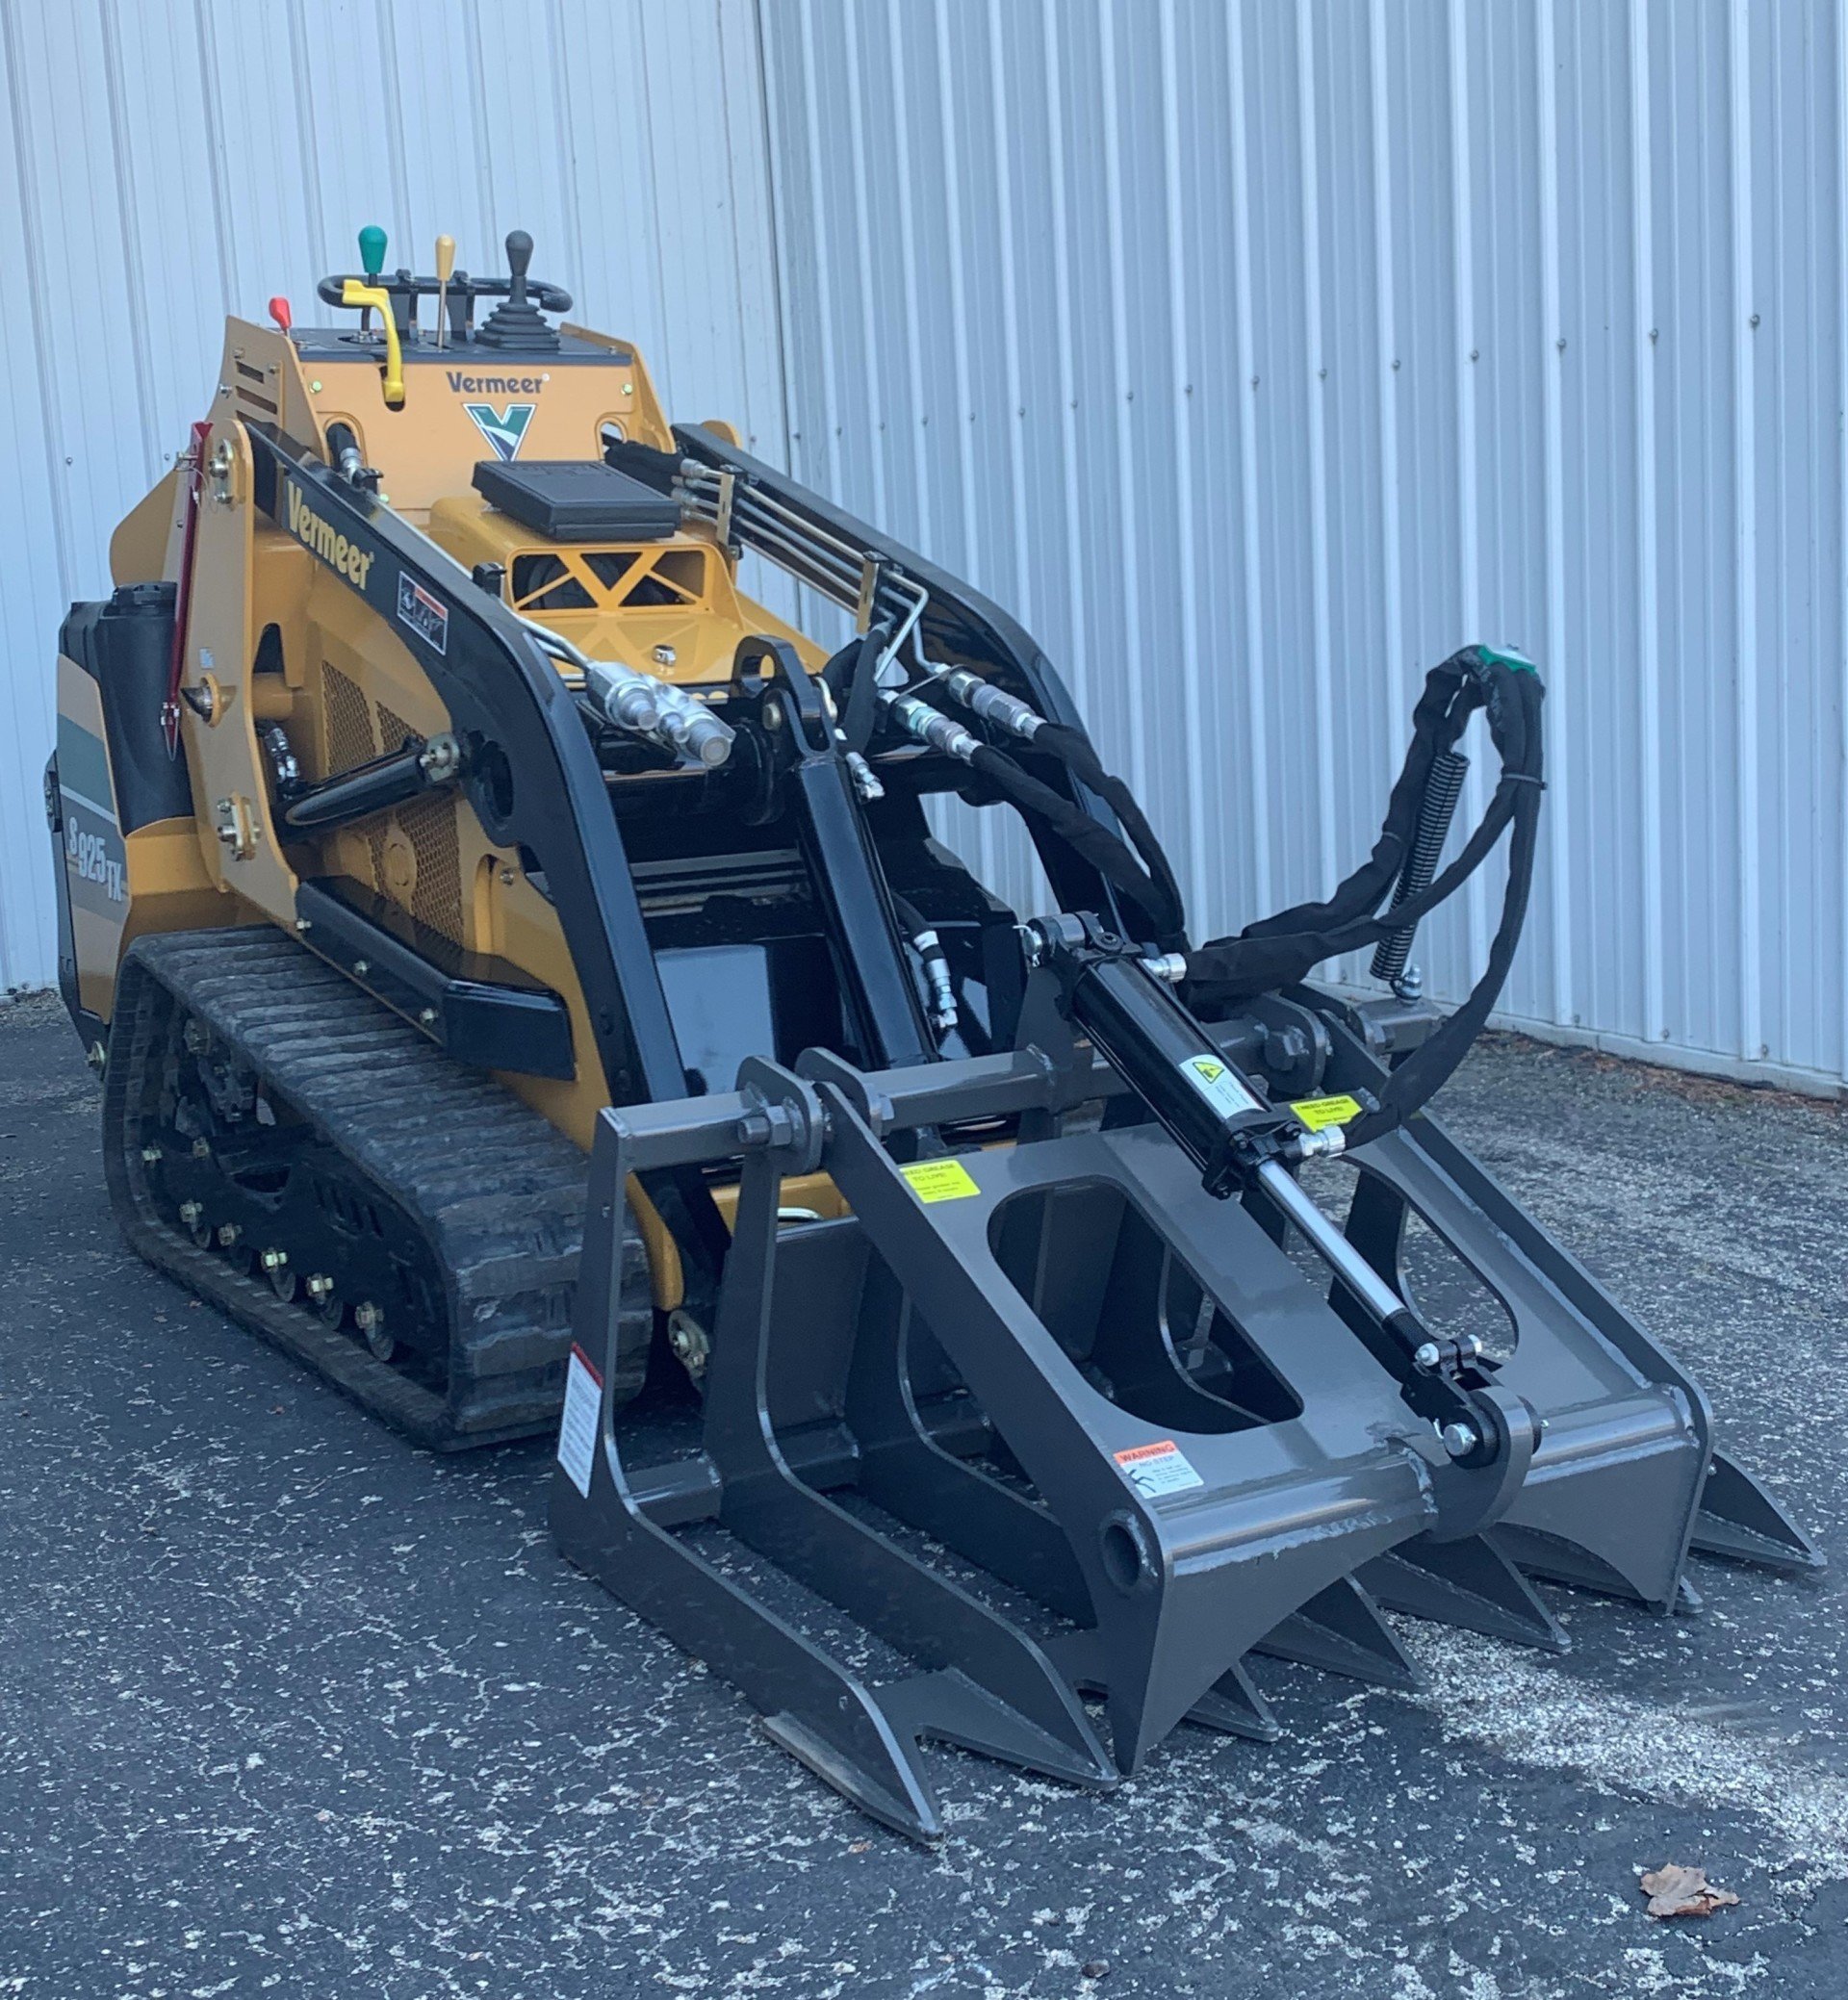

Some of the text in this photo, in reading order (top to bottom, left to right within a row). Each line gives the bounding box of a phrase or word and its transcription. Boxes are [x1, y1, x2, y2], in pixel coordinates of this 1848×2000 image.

[446, 372, 543, 394] Vermeer
[288, 480, 370, 590] Vermeer
[1119, 1444, 1175, 1462] WARNING
[1153, 1454, 1174, 1464] STEP
